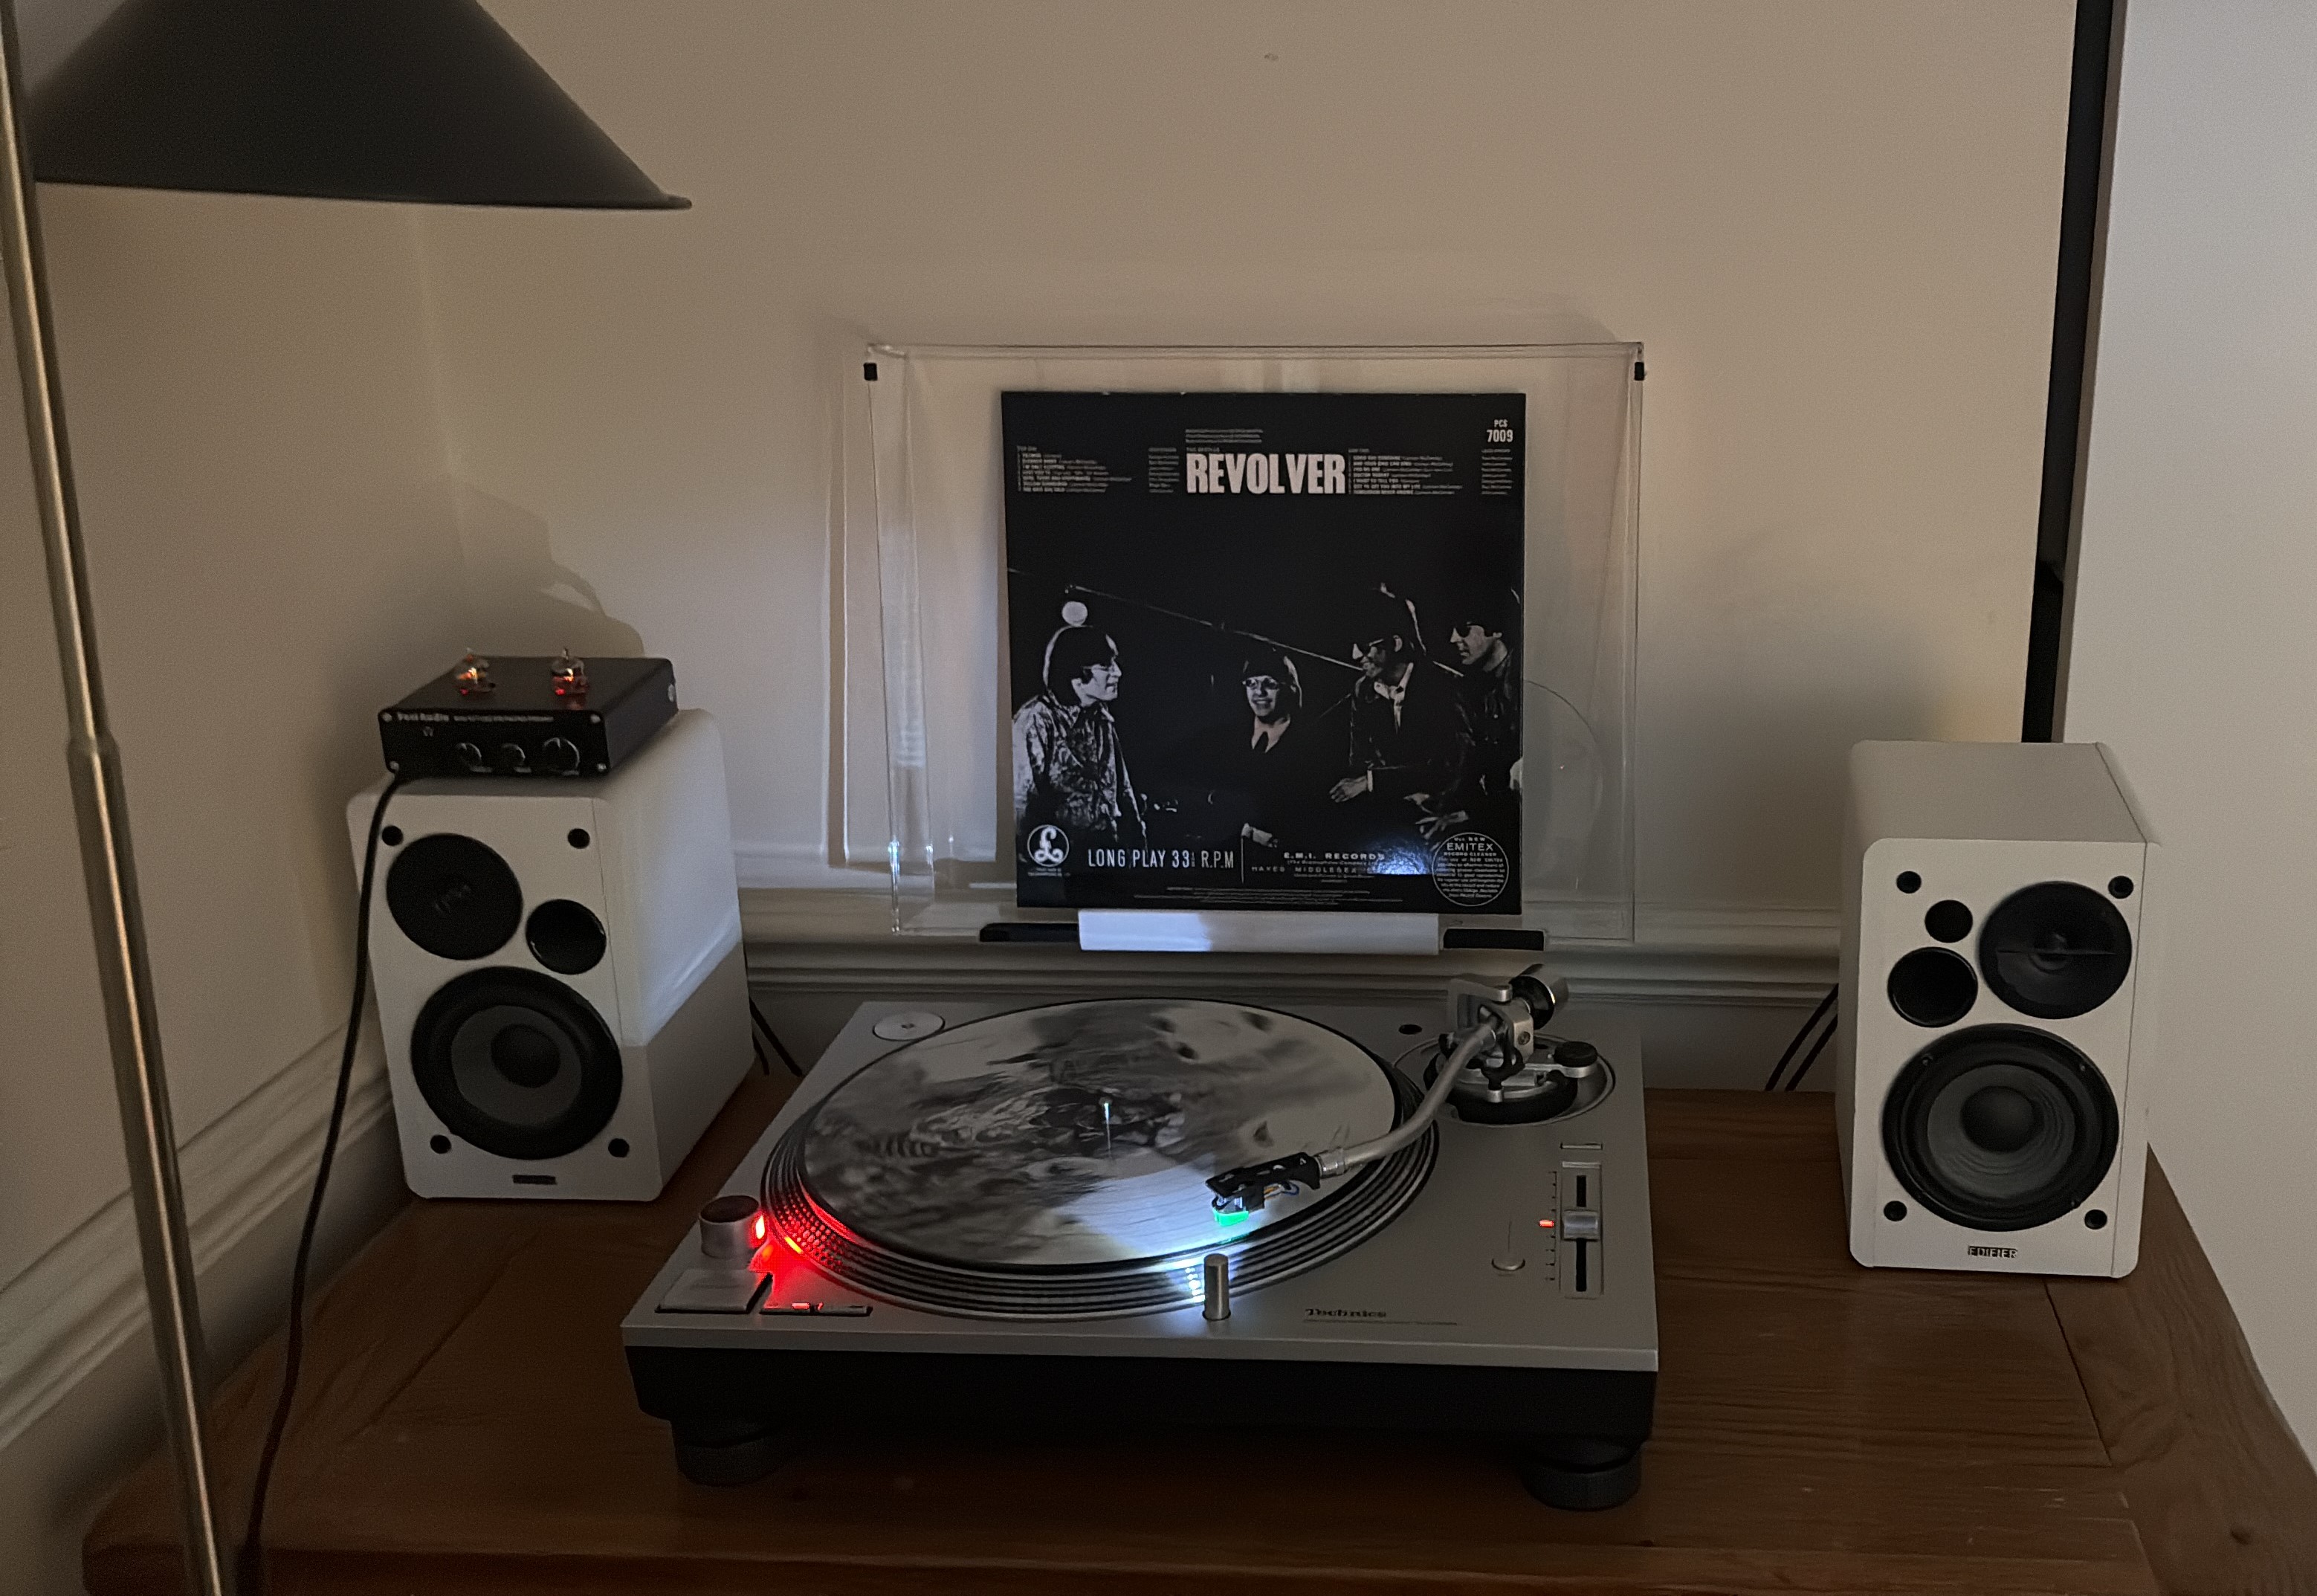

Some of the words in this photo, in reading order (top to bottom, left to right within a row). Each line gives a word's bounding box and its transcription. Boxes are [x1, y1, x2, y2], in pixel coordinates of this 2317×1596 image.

[1493, 419, 1508, 428] PCS
[1487, 429, 1513, 443] 7009
[1186, 453, 1346, 494] REVOLVER
[1447, 842, 1494, 852] EMITEX
[1088, 848, 1125, 868] LONG
[1132, 849, 1166, 868] PLAY
[1325, 852, 1385, 861] RECORDS
[1968, 1246, 2018, 1259] EDIFIER
